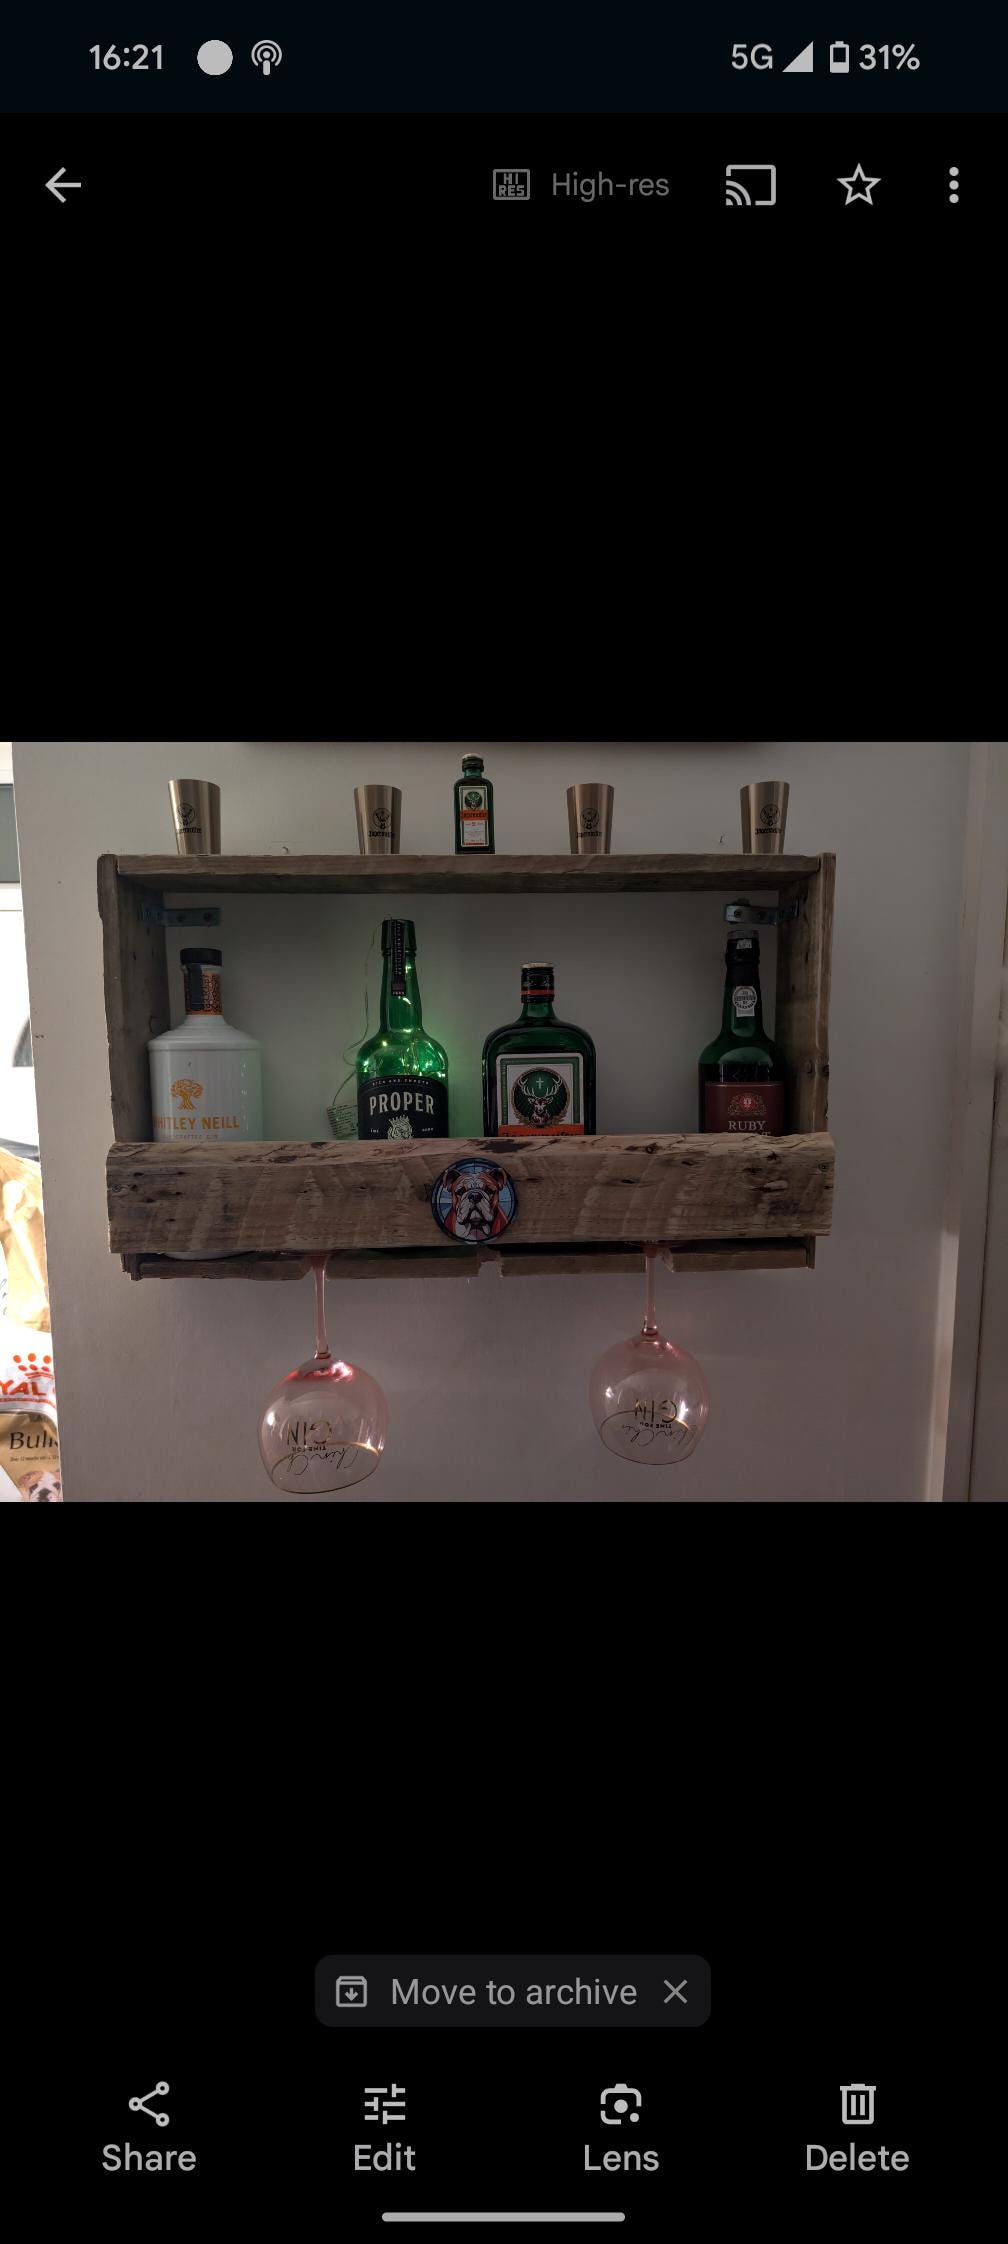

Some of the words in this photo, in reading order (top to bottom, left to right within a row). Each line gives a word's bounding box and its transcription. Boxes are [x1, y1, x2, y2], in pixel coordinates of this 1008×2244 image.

[89, 43, 164, 71] 16:21
[731, 43, 773, 71] 5G
[858, 43, 921, 71] 31%
[498, 185, 524, 196] RES
[503, 172, 518, 184] HI
[551, 171, 670, 203] High-res
[369, 1091, 434, 1116] PROPER
[201, 1115, 240, 1130] NEILL
[728, 1120, 767, 1131] RUBY
[0, 1379, 46, 1396] YAL
[635, 1399, 677, 1424] GIN
[287, 1420, 332, 1445] GIN
[390, 1978, 476, 2006] Move
[486, 1979, 516, 2006] to
[525, 1977, 637, 2006] archive
[102, 2142, 197, 2172] Share
[353, 2142, 416, 2172] Edit
[583, 2143, 659, 2172] Lens
[805, 2142, 910, 2172] Delete
